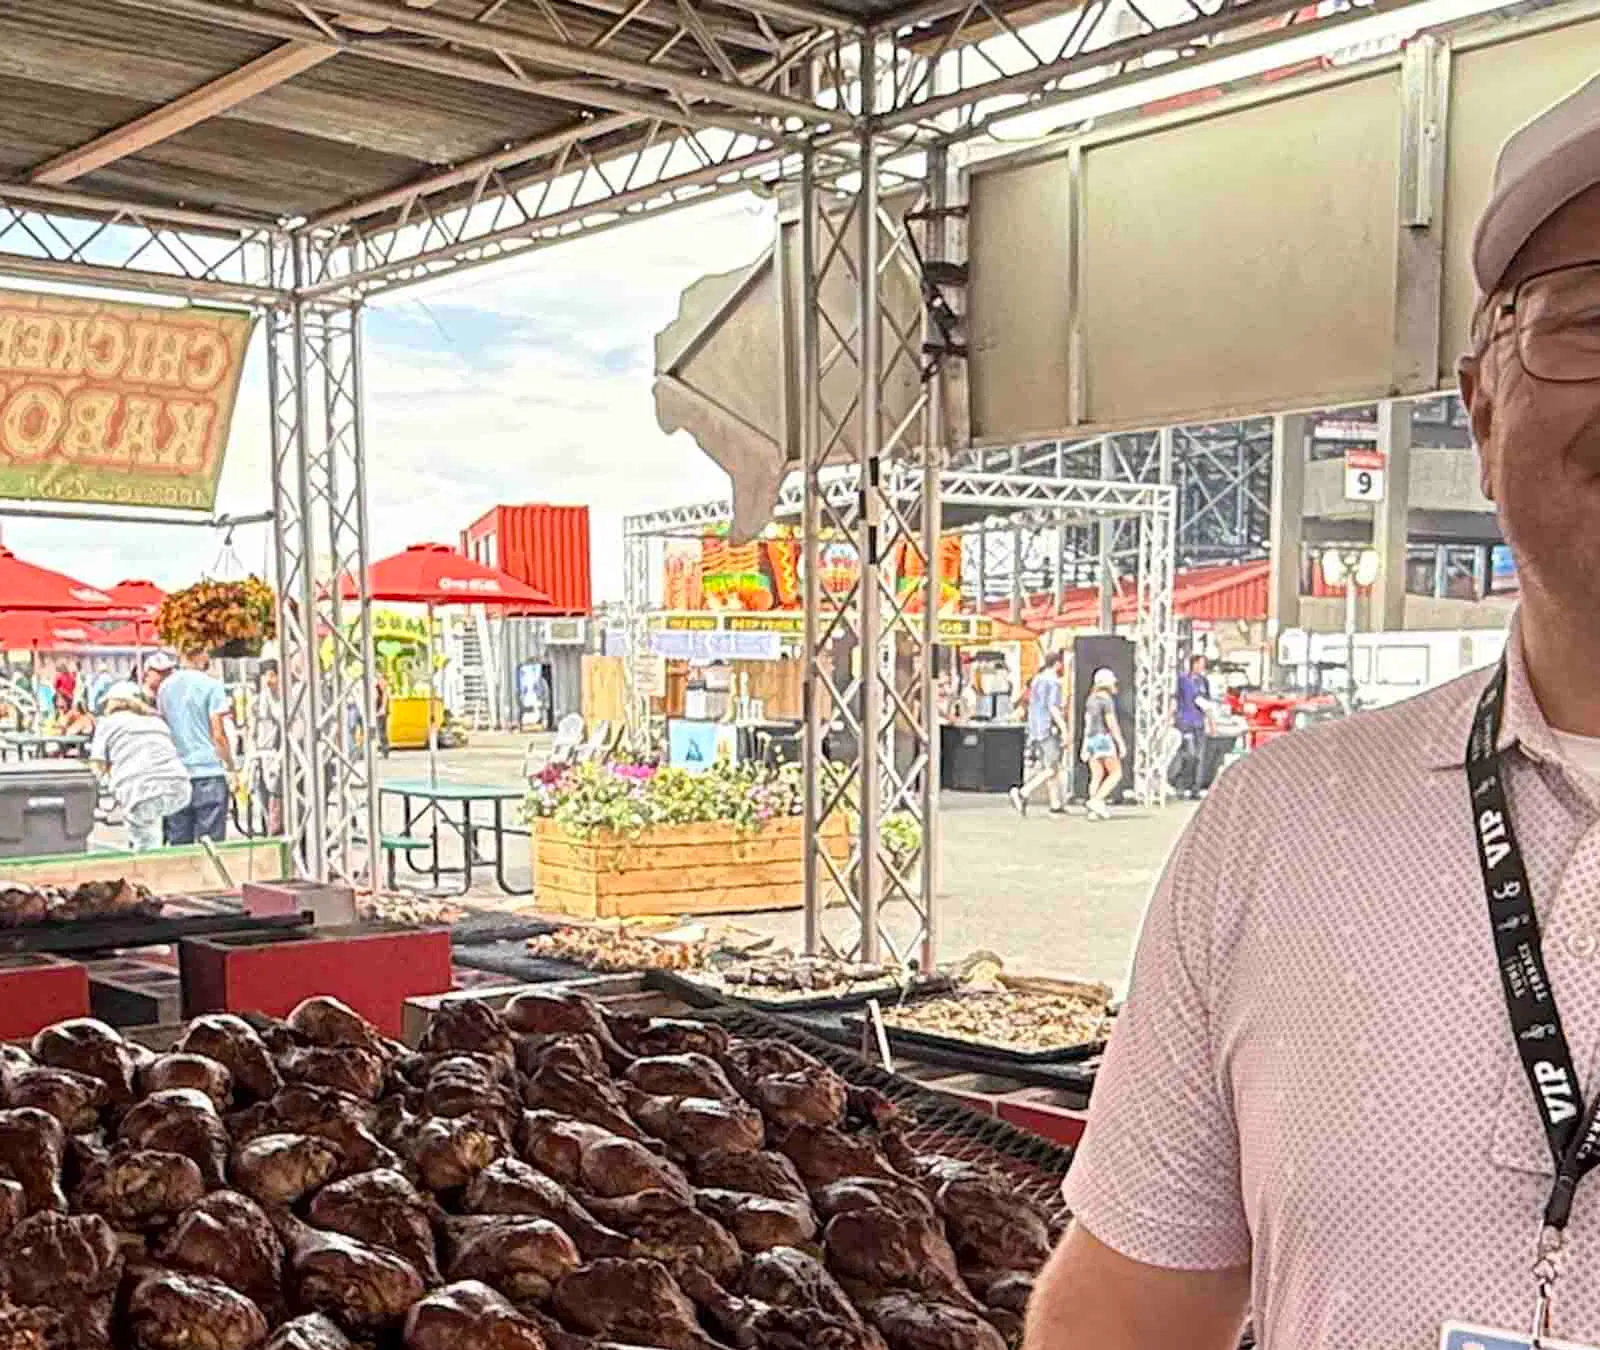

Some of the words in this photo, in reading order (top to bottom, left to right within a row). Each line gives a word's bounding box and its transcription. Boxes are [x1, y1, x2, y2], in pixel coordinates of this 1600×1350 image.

[1358, 472, 1372, 494] 9
[1478, 809, 1512, 869] VIP
[1533, 1059, 1577, 1126] VIP
